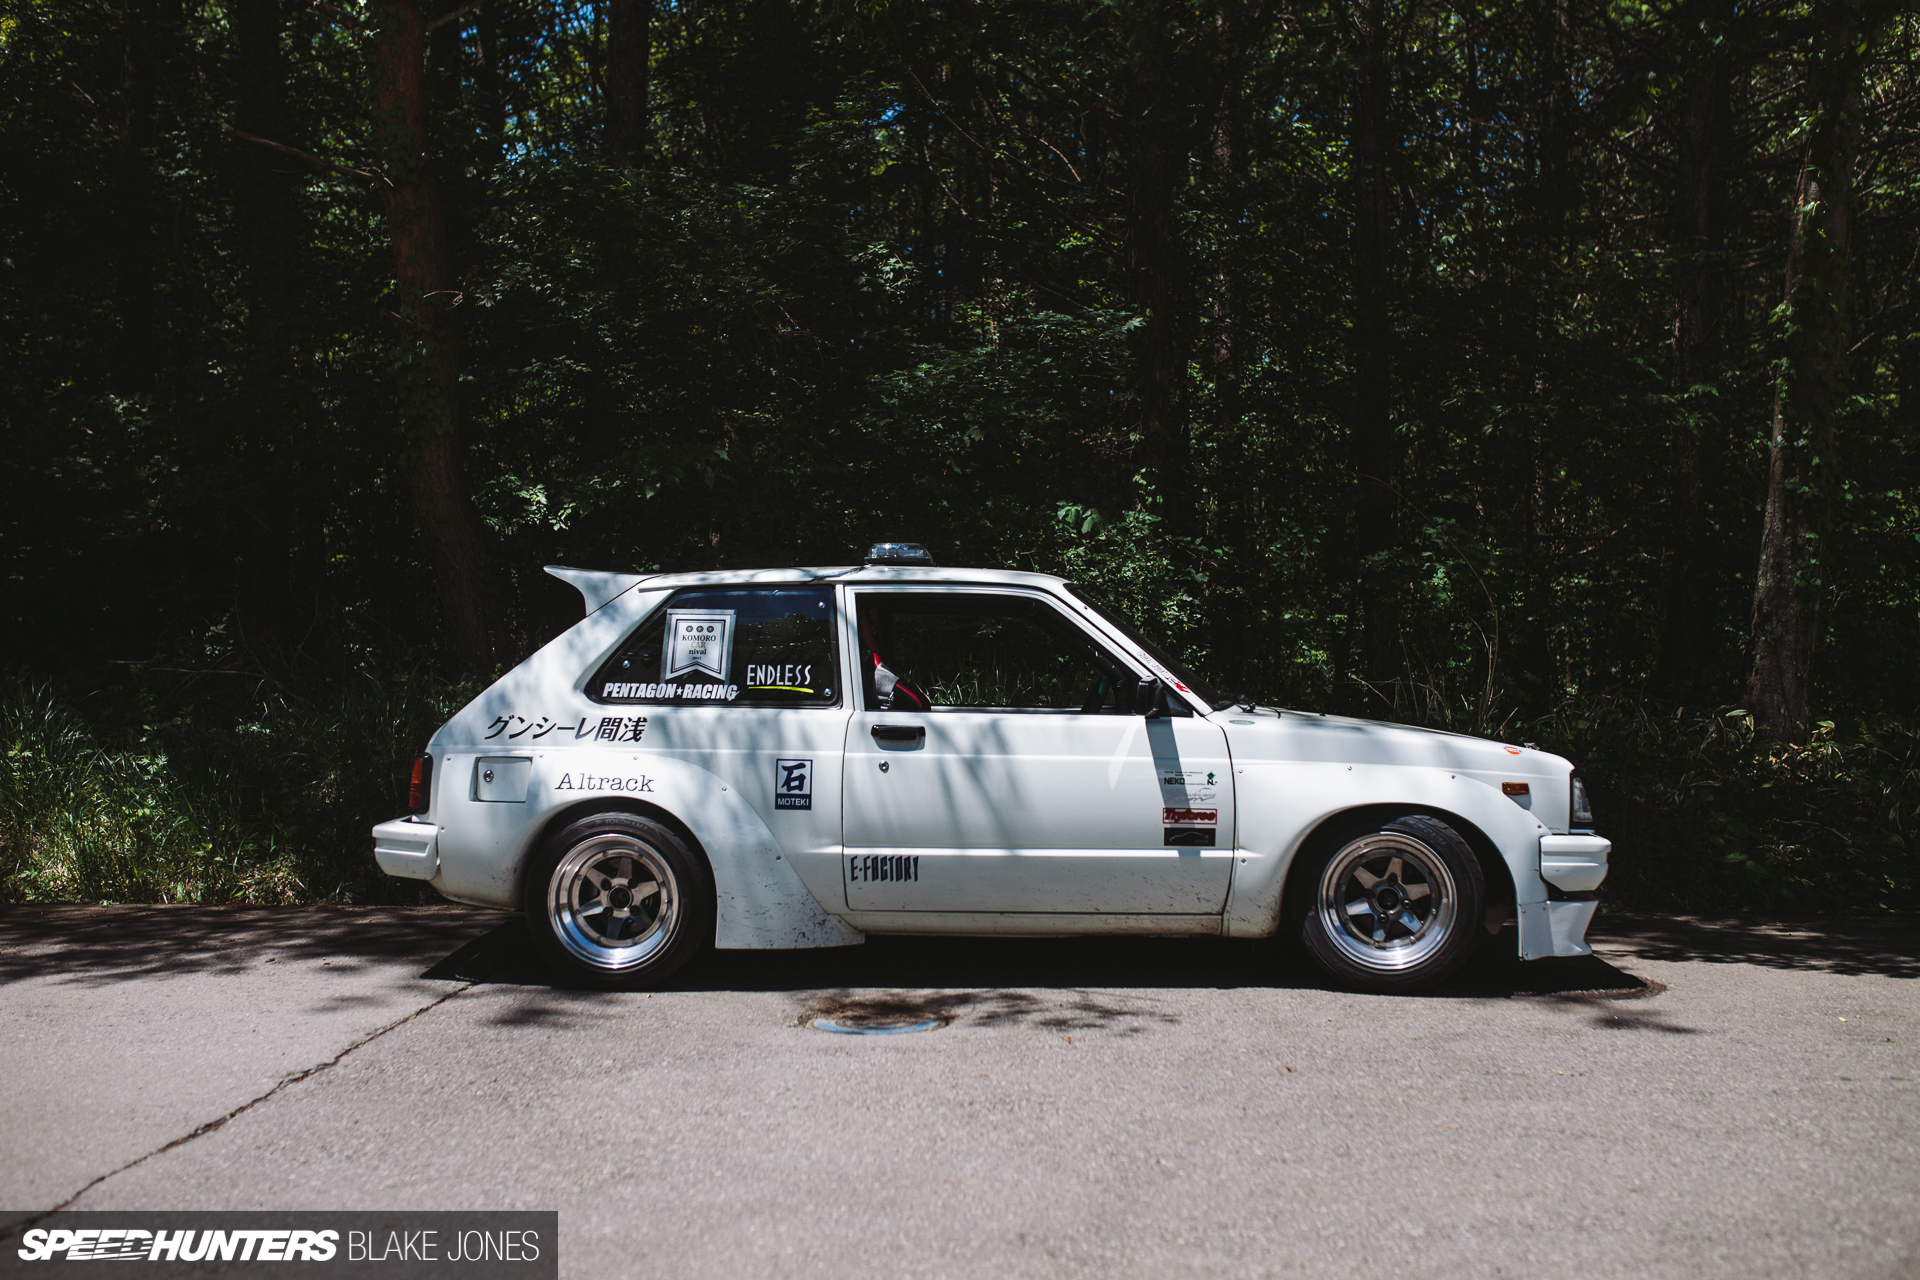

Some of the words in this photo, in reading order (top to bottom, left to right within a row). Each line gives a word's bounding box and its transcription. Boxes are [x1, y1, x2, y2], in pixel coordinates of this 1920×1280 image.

[682, 634, 717, 642] KOMORO
[690, 641, 706, 649] CAR
[747, 664, 812, 686] ENDLESS
[484, 714, 648, 743] グンシーレ間浅
[554, 772, 655, 793] Altrack
[781, 762, 807, 792] 石
[1164, 777, 1185, 785] NEKO
[777, 797, 809, 806] MOTEKI
[604, 818, 649, 832] YOKOHAMA
